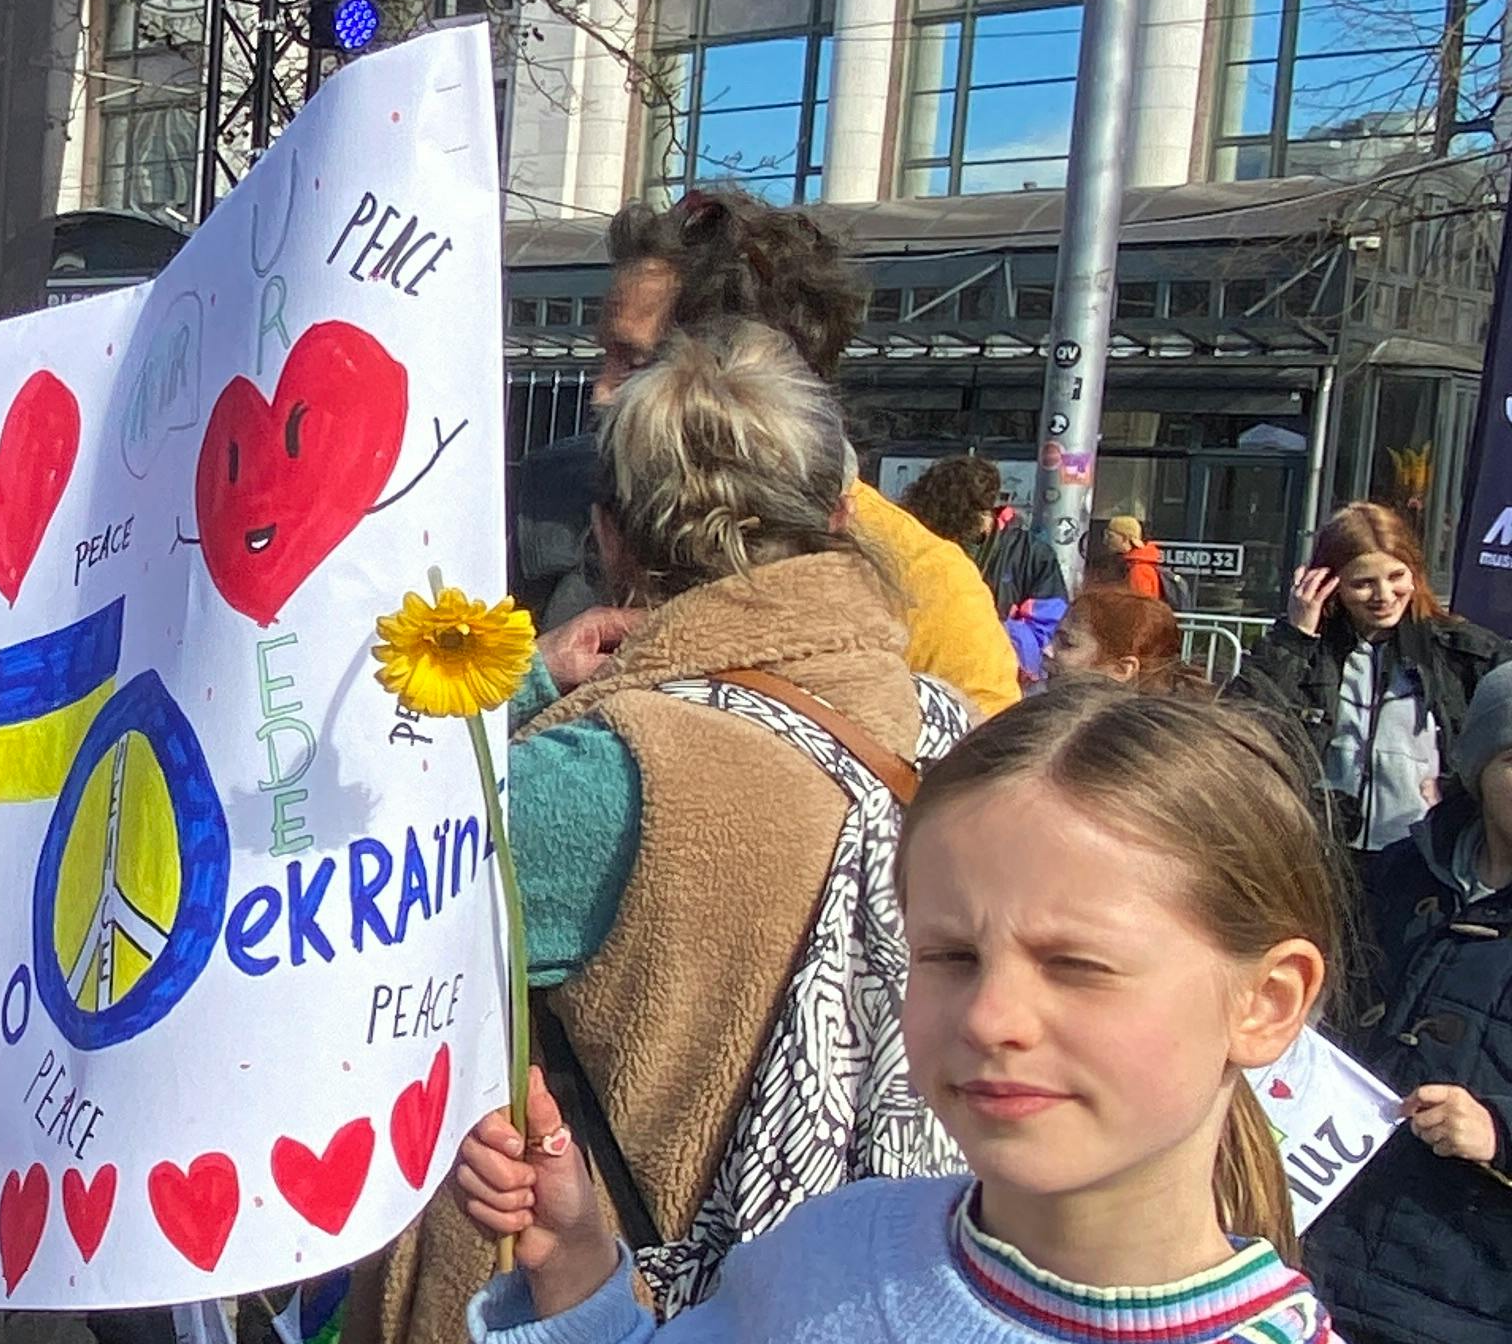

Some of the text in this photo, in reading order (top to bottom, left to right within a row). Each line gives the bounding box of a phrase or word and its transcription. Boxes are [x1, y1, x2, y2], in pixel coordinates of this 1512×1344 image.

[326, 191, 453, 297] PEACE
[74, 513, 135, 587] PEACE
[366, 973, 464, 1045] PEACE
[23, 1049, 104, 1161] PEACE
